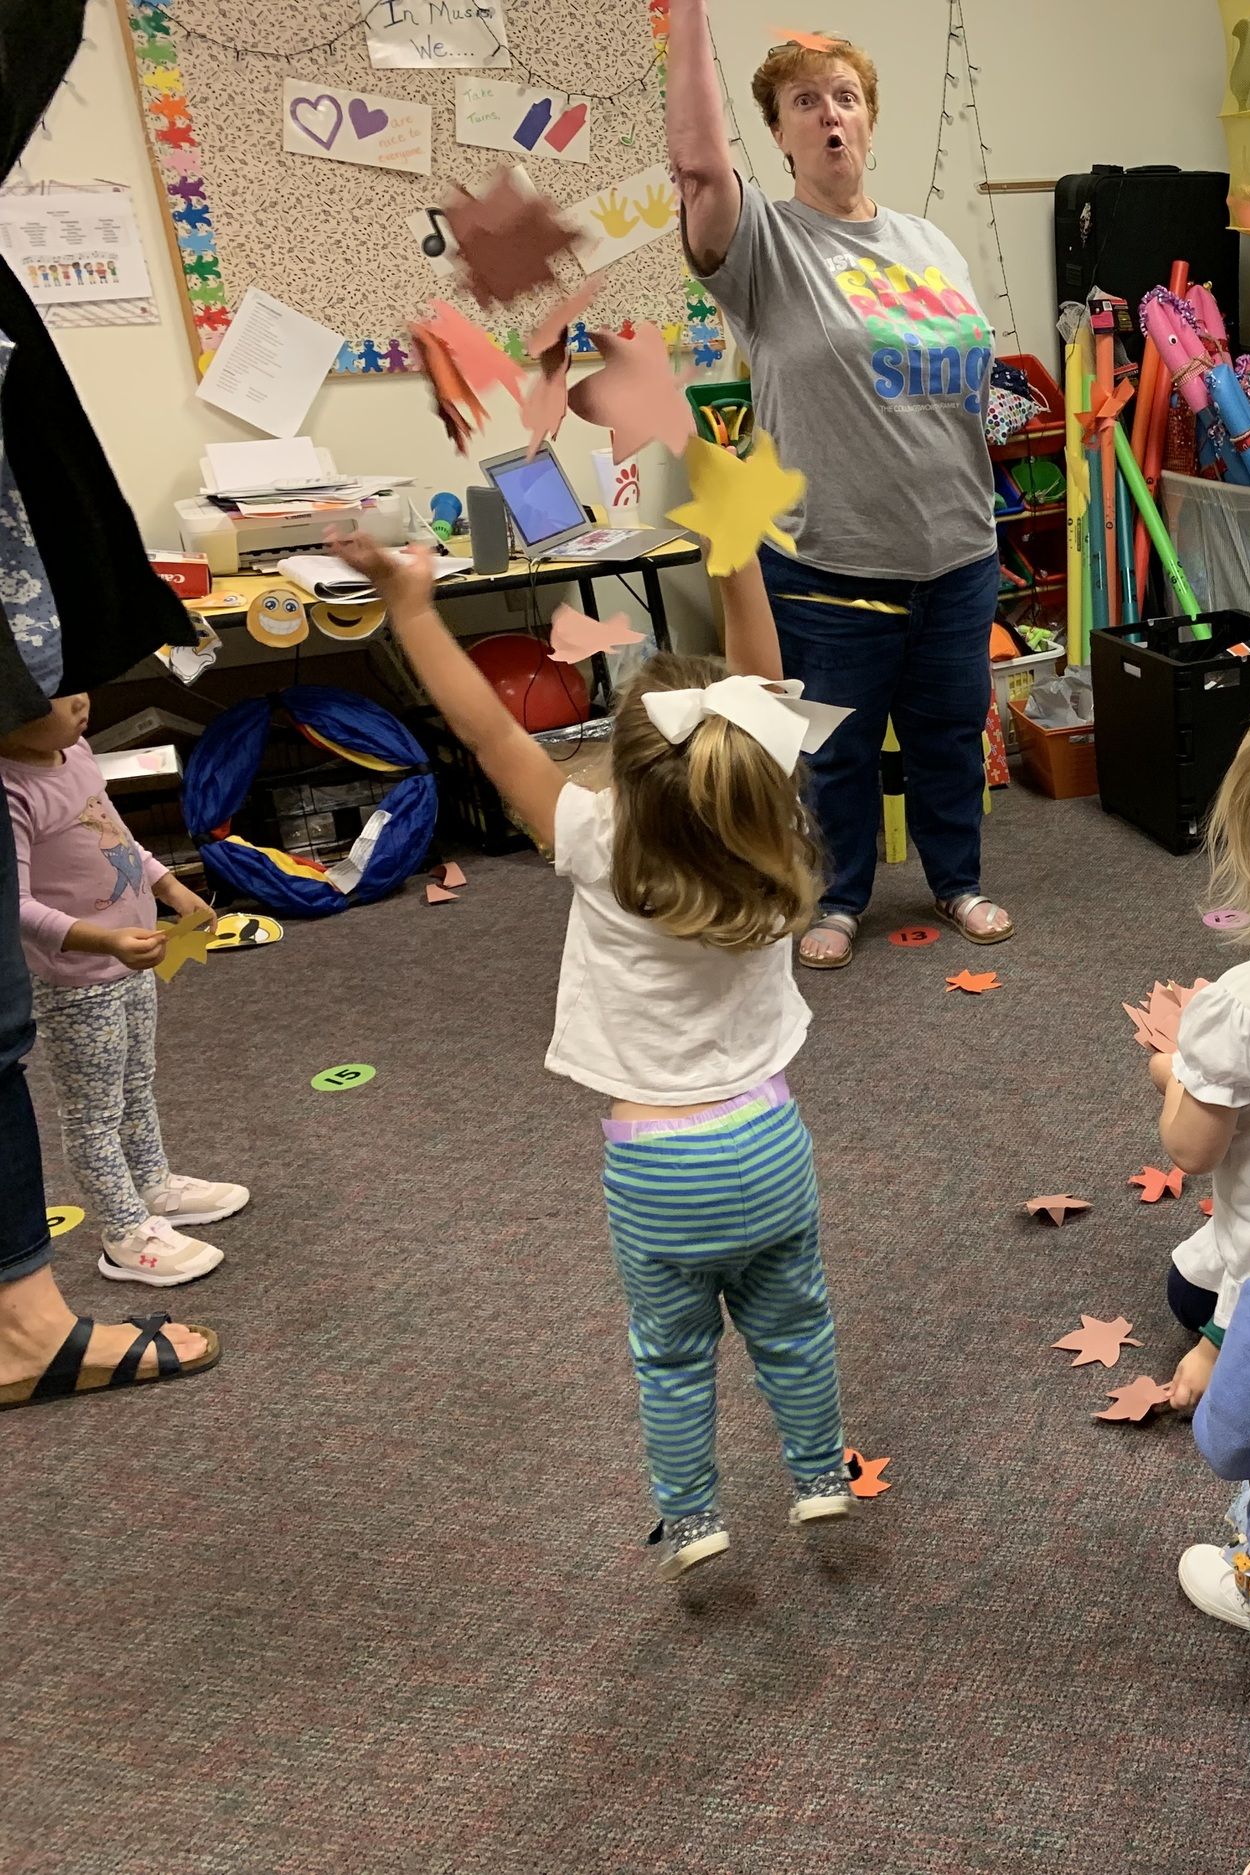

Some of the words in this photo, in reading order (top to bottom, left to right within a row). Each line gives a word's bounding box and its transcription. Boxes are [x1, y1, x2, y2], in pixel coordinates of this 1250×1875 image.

[380, 0, 419, 28] In
[463, 88, 494, 102] Take
[391, 116, 413, 128] are
[379, 134, 406, 147] nice
[409, 127, 421, 138] to
[901, 930, 928, 942] 13
[324, 1069, 361, 1085] 15
